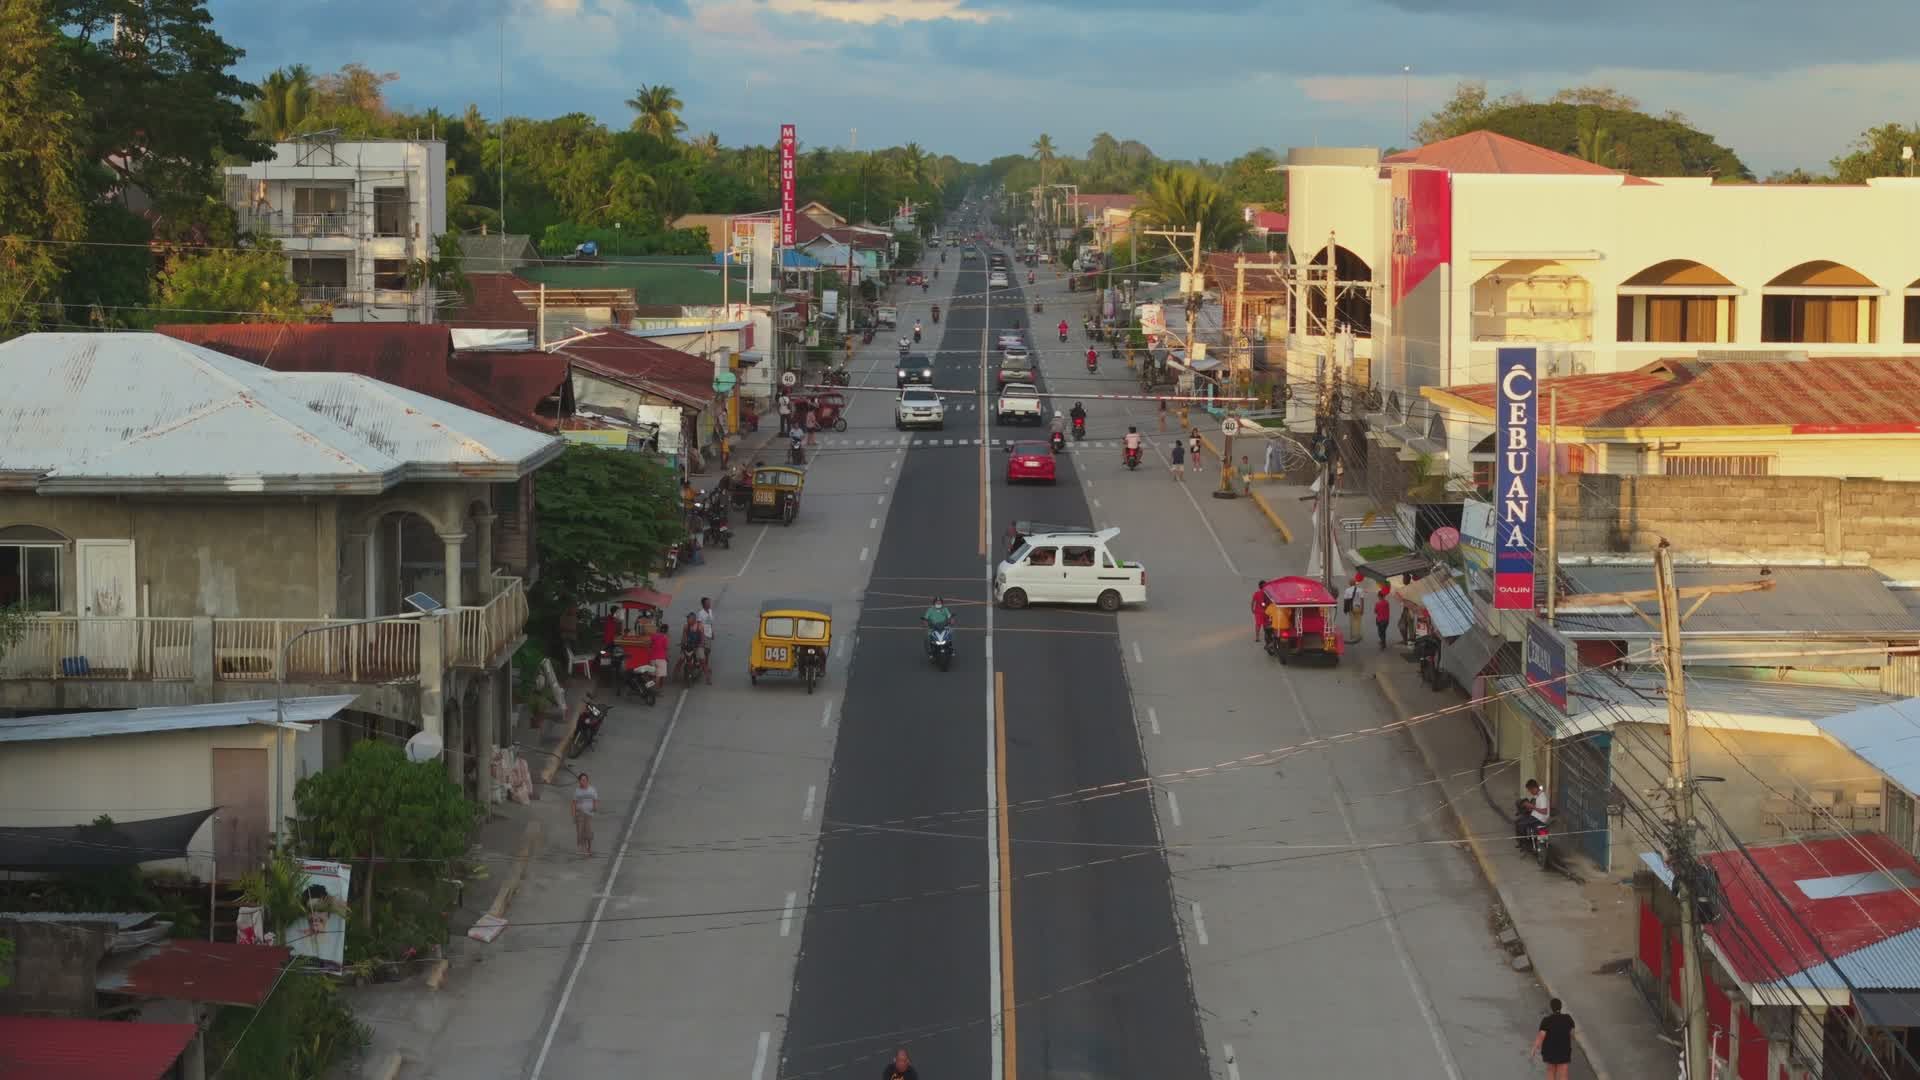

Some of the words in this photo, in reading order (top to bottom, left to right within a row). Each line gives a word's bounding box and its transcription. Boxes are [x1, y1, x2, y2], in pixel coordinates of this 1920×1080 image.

[784, 149, 793, 243] LHUILLIER
[1502, 364, 1532, 547] CEBUANA
[765, 647, 788, 661] 049
